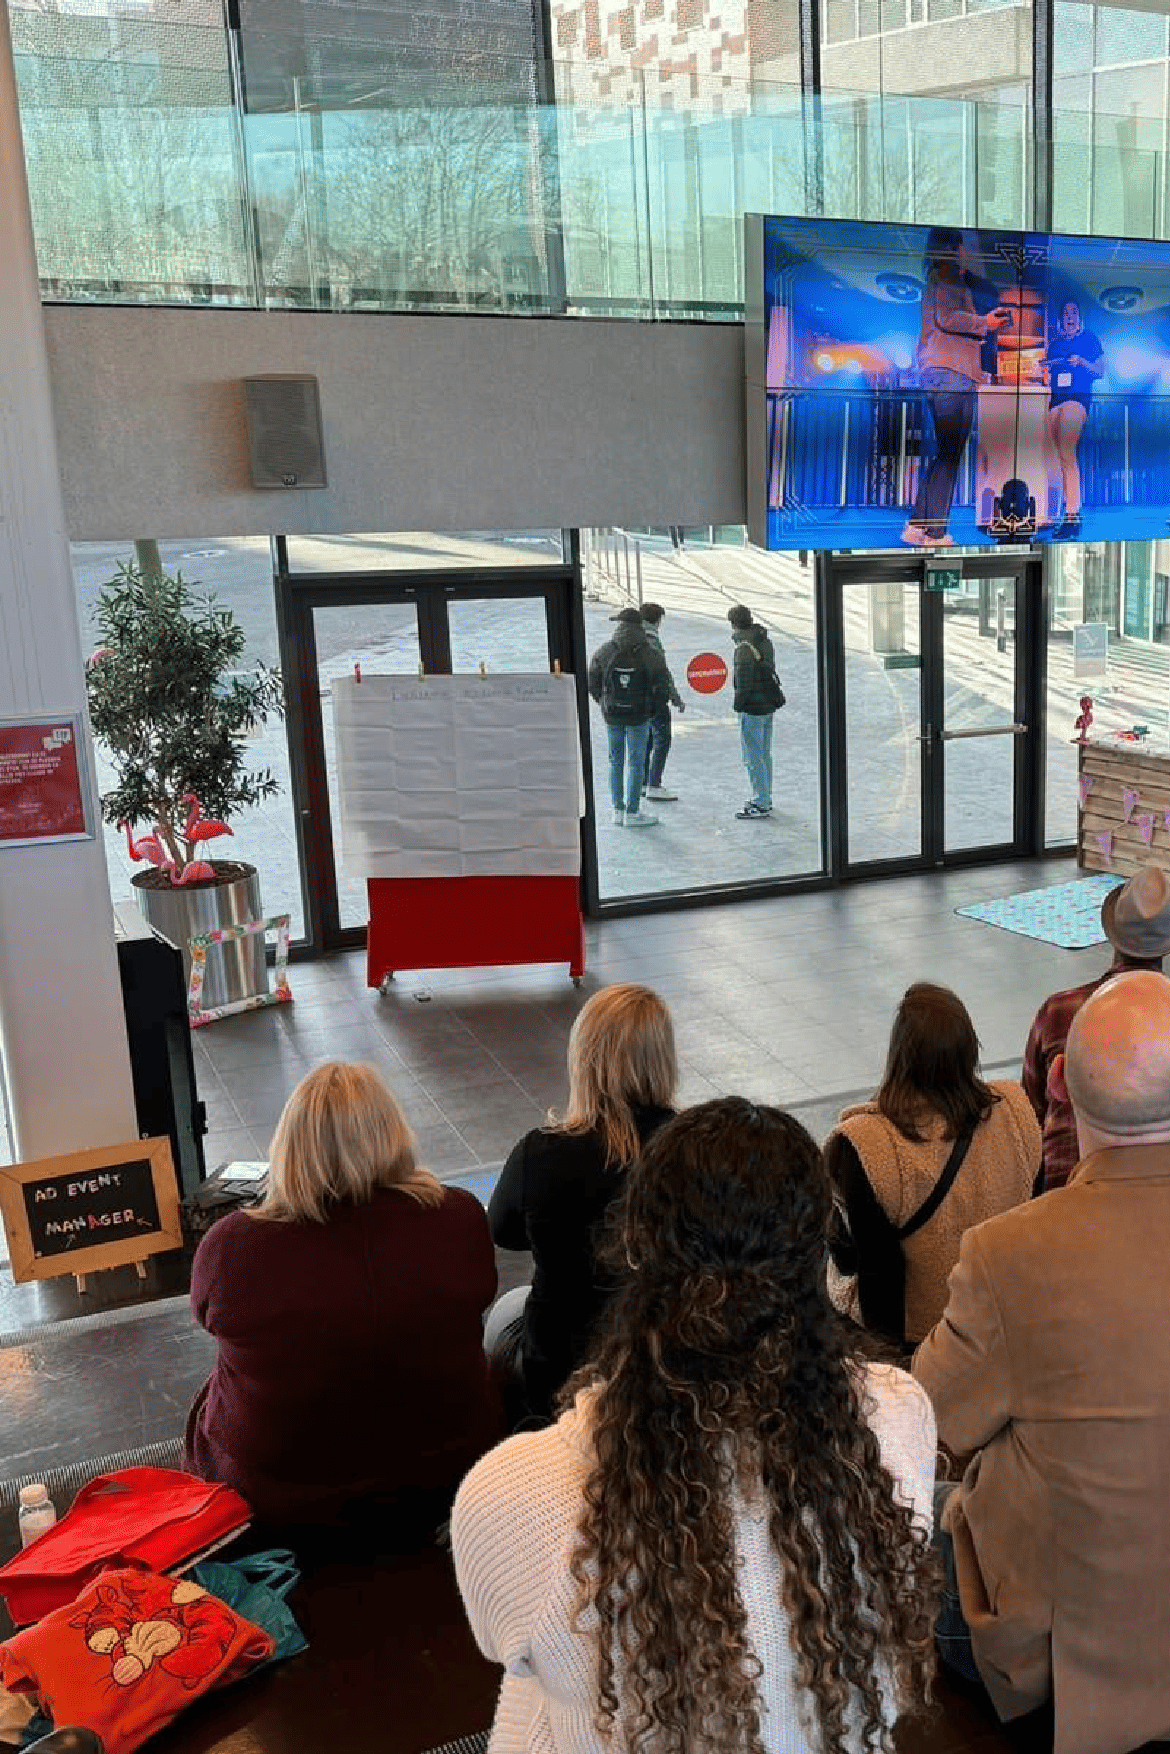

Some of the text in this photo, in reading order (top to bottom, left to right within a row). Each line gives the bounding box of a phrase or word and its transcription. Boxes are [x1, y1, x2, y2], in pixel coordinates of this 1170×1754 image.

[35, 1174, 121, 1203] AD EVENT
[45, 1209, 135, 1236] MANAGER
